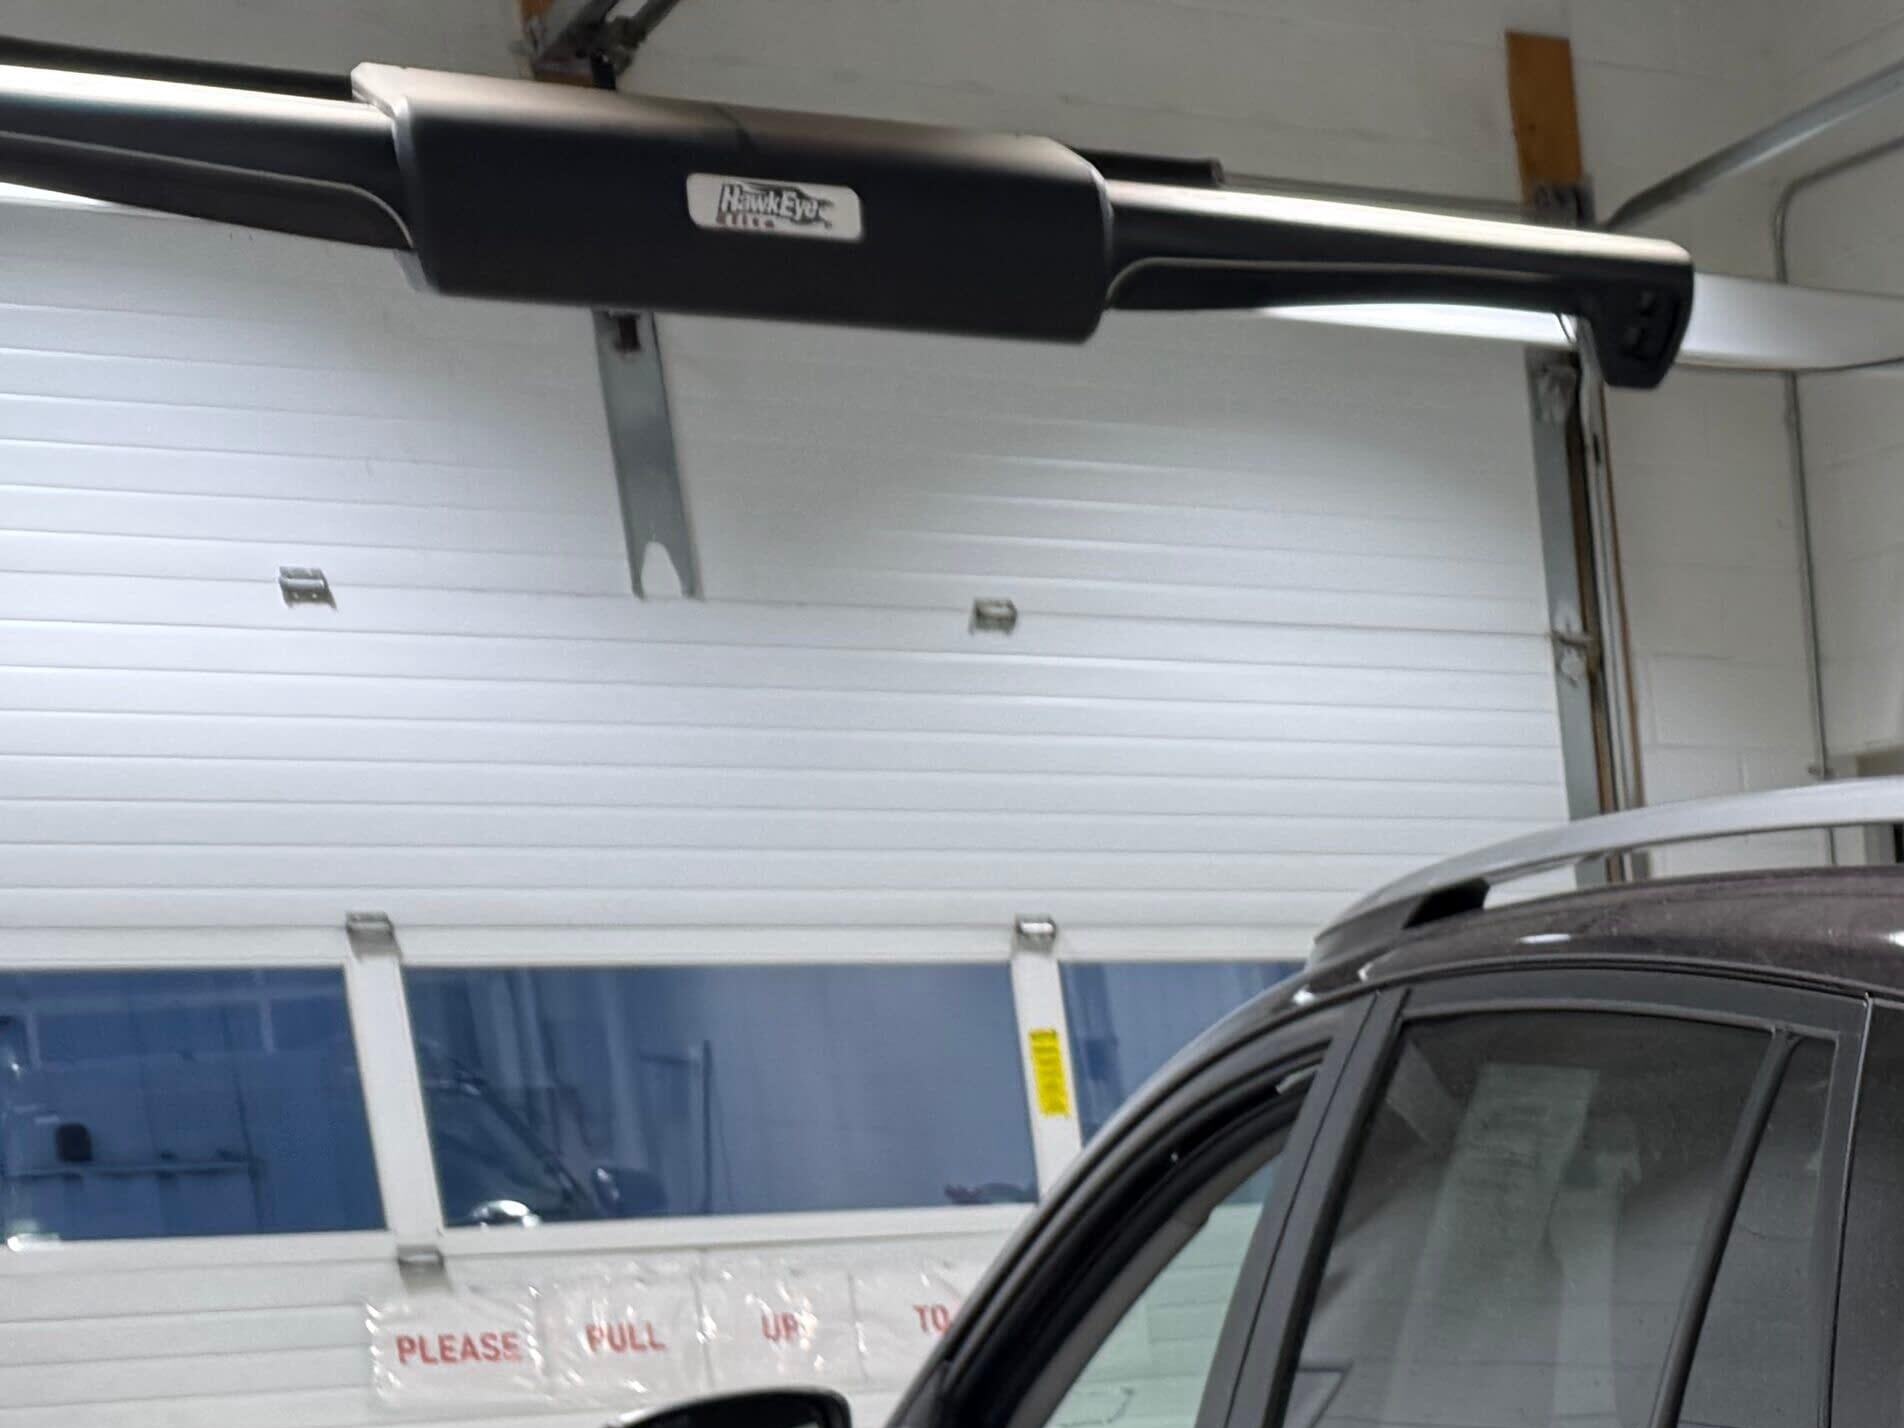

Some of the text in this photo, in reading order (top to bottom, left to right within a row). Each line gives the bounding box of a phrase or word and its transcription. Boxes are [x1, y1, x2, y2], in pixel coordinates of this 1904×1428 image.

[396, 1303, 952, 1365] PLEASE PULL UP TO
